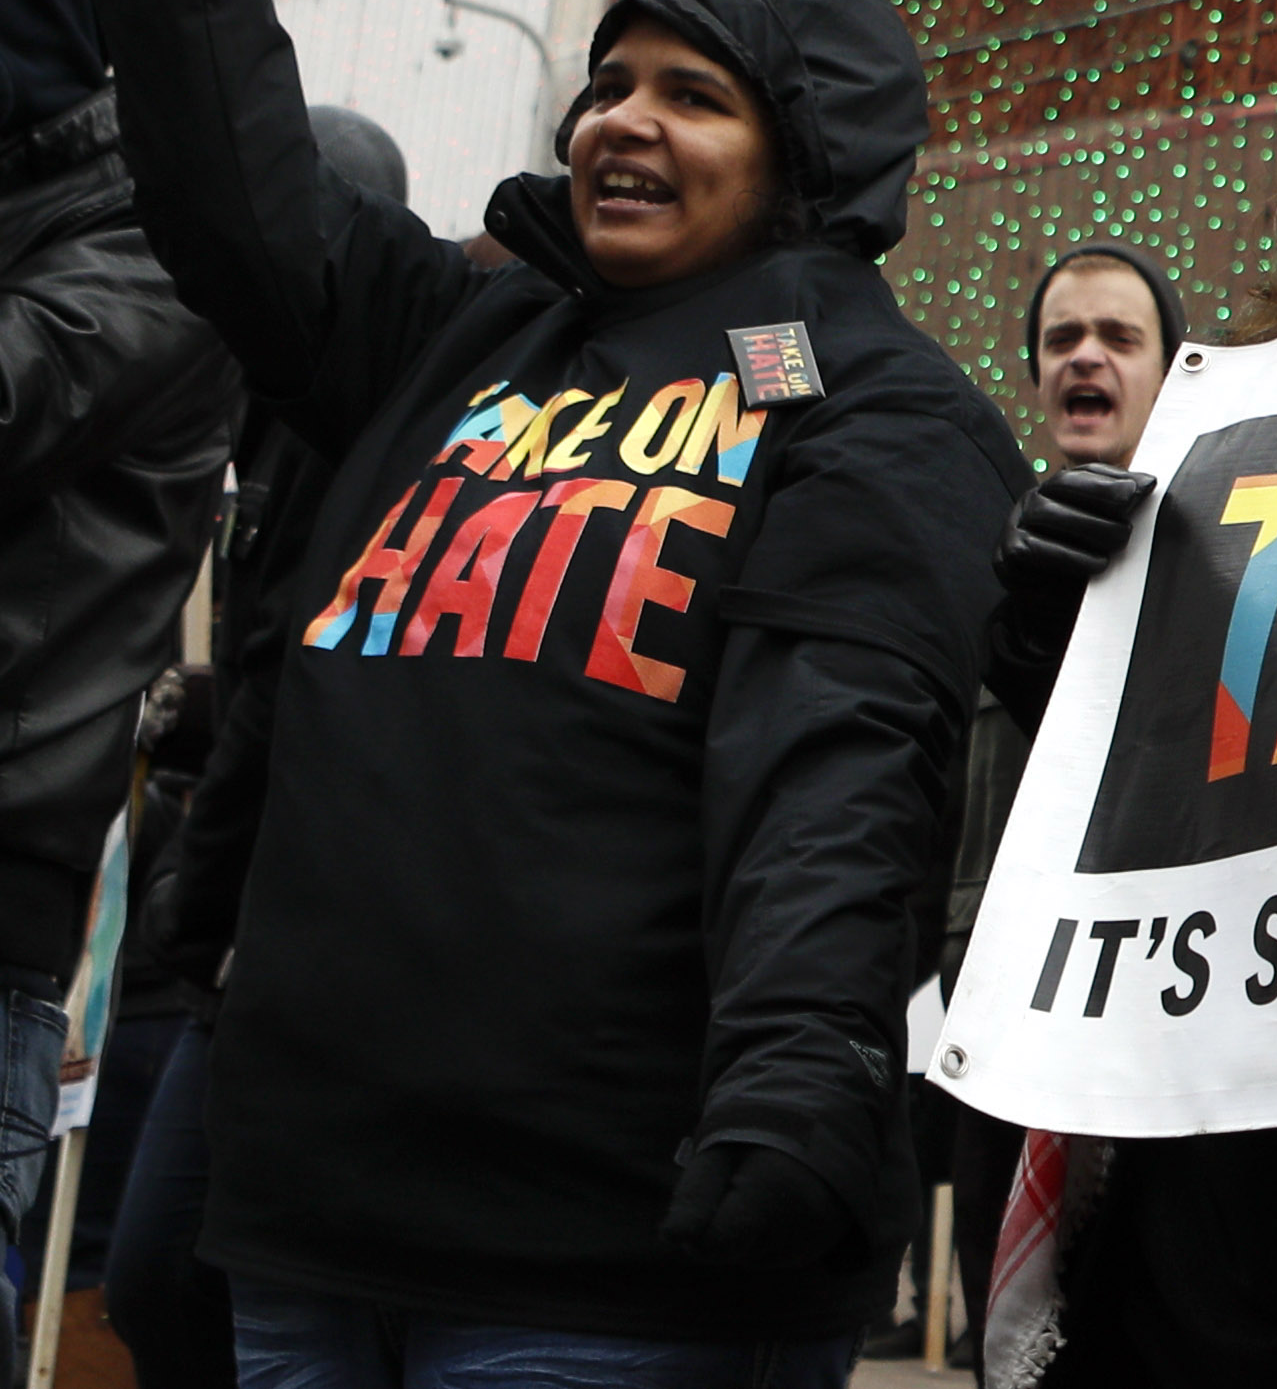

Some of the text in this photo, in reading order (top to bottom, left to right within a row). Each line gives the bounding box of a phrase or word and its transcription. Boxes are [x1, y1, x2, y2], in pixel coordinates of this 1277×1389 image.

[742, 333, 792, 401] HATE
[775, 327, 805, 371] TAKE
[619, 371, 767, 488] ON
[303, 476, 736, 705] HATE
[1029, 908, 1217, 1020] IT'S
